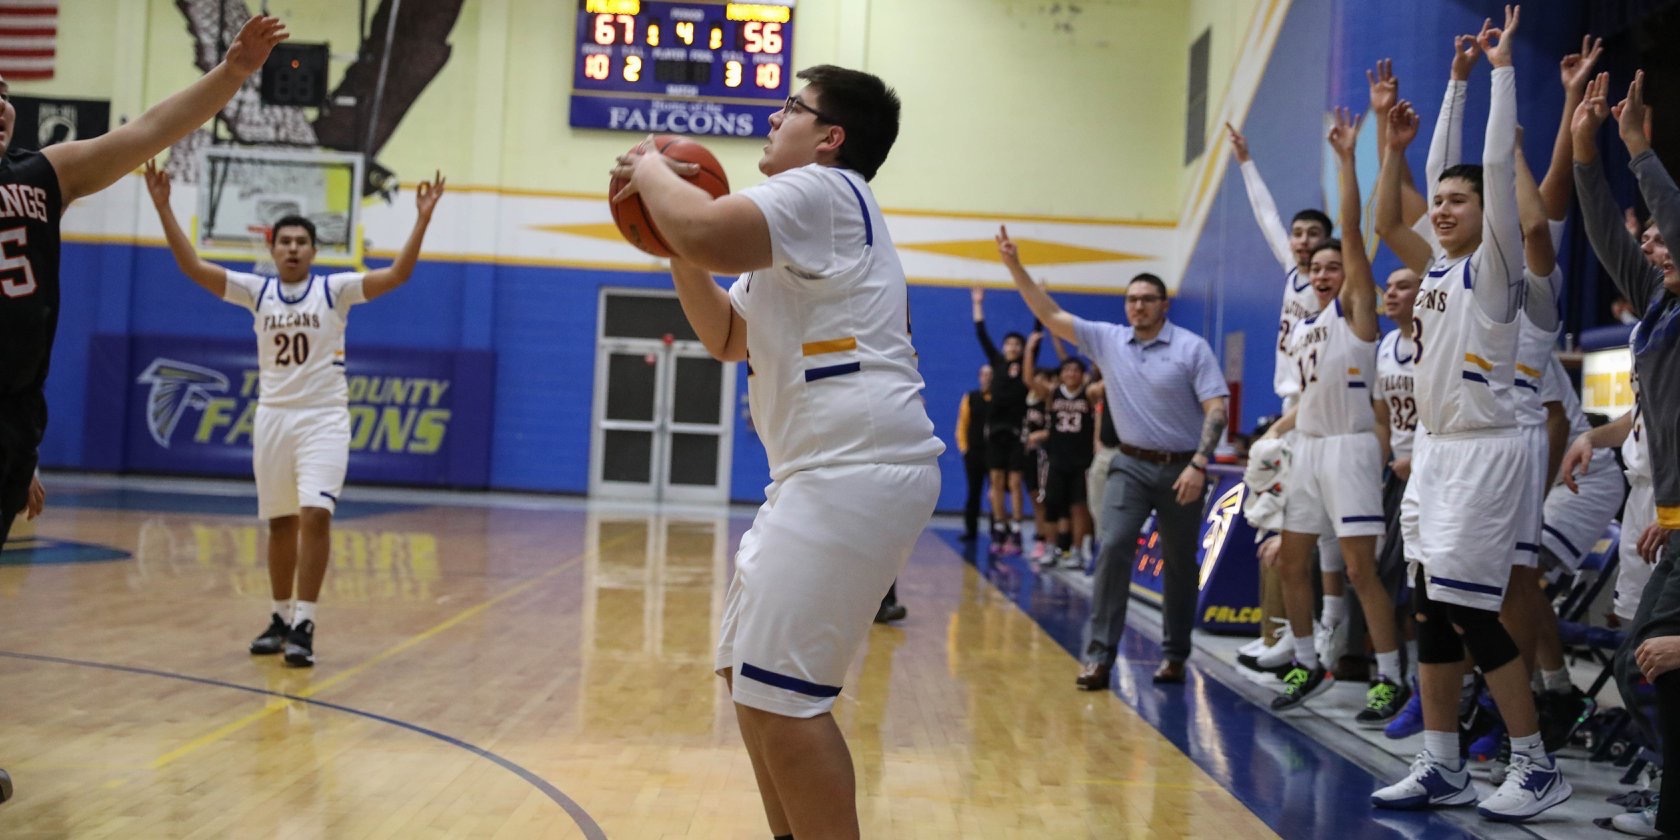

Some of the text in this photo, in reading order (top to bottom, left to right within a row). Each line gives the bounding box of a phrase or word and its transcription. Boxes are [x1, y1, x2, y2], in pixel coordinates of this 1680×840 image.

[595, 14, 634, 45] 67
[676, 22, 694, 45] 4
[744, 22, 783, 54] 56
[585, 54, 610, 80] 10
[623, 55, 642, 82] 2
[725, 61, 742, 87] 3
[756, 63, 781, 89] 10
[609, 107, 754, 136] FALCONS
[263, 313, 321, 330] FALCONS
[274, 333, 310, 366] 20
[347, 376, 450, 405] OUNTY
[195, 396, 452, 454] FAONS
[1056, 411, 1082, 433] 33
[1391, 396, 1417, 432] 32
[1203, 606, 1263, 623] FALCO
